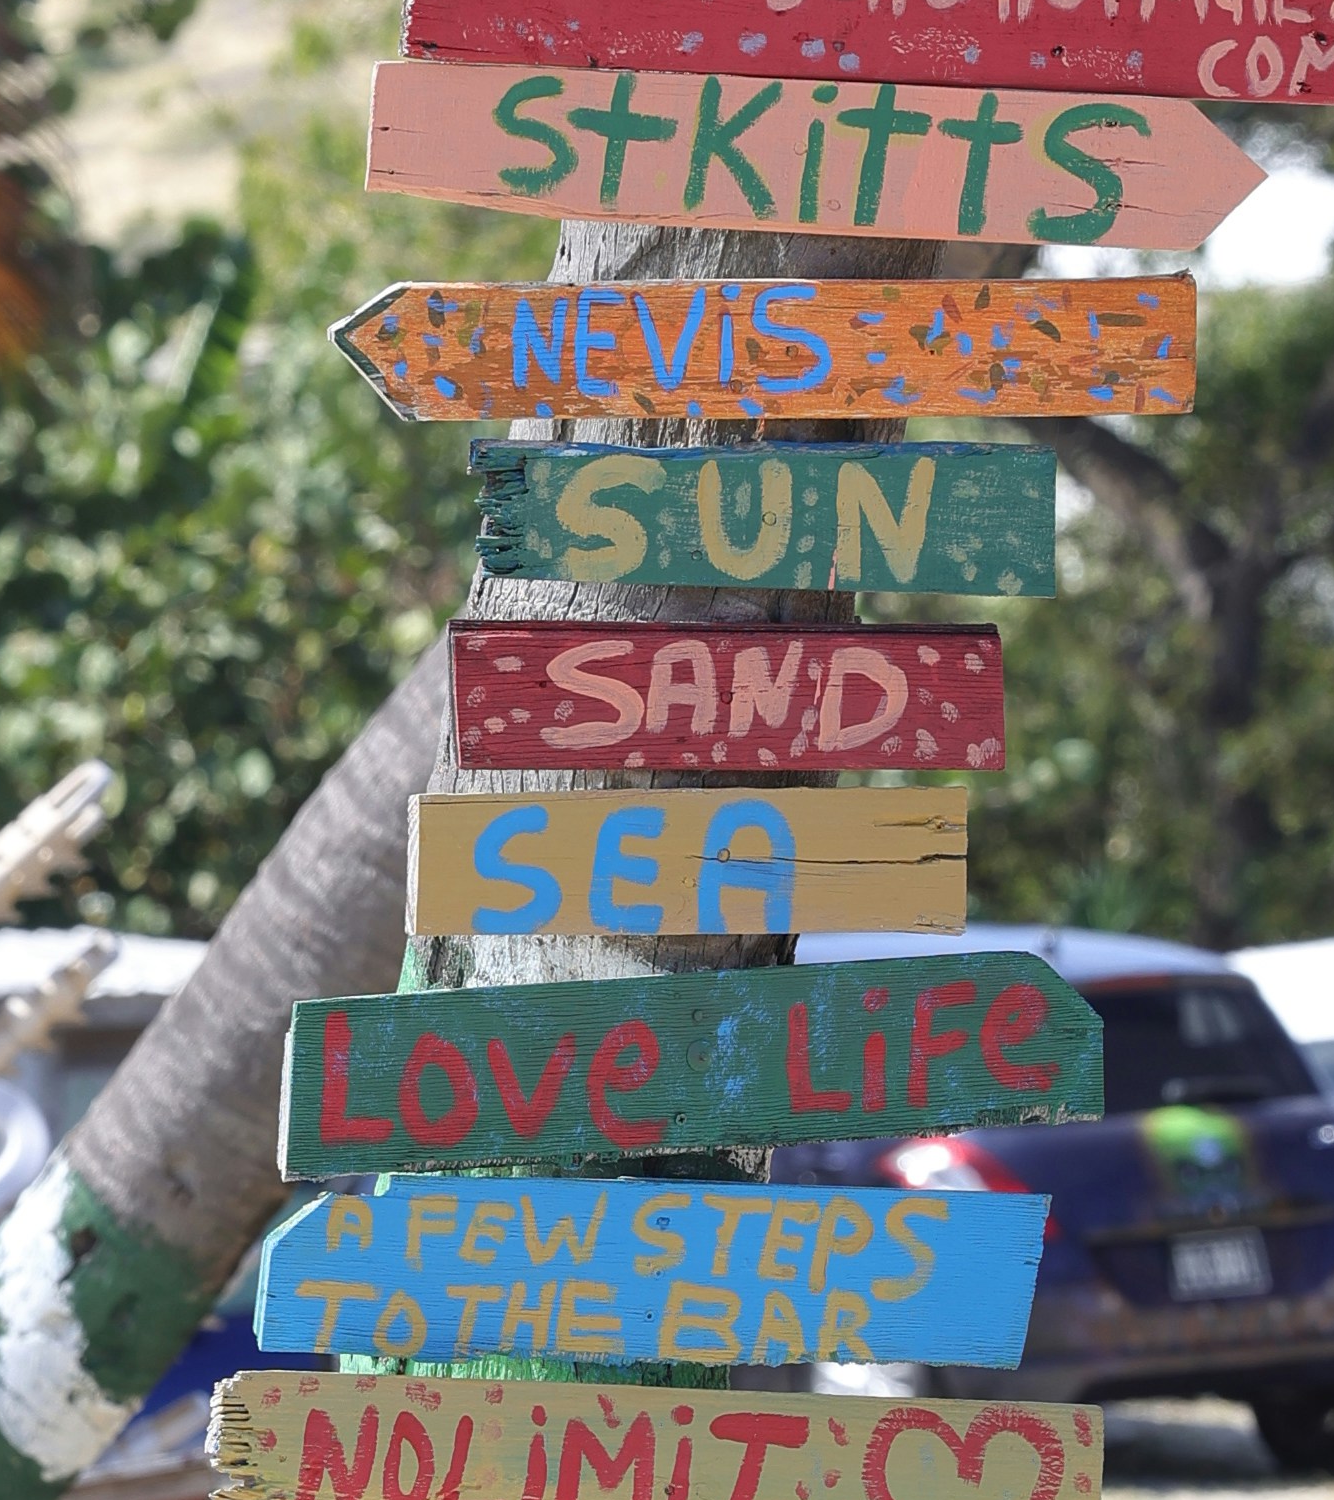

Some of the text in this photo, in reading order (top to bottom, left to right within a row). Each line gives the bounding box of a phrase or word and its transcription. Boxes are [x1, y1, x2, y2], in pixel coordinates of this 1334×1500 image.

[555, 453, 935, 582] SUN
[539, 638, 909, 752] SAND
[471, 800, 797, 935] SEA
[325, 1193, 951, 1304] A FEW STEPS
[445, 1281, 622, 1356] THE
[657, 1281, 873, 1363] BAR
